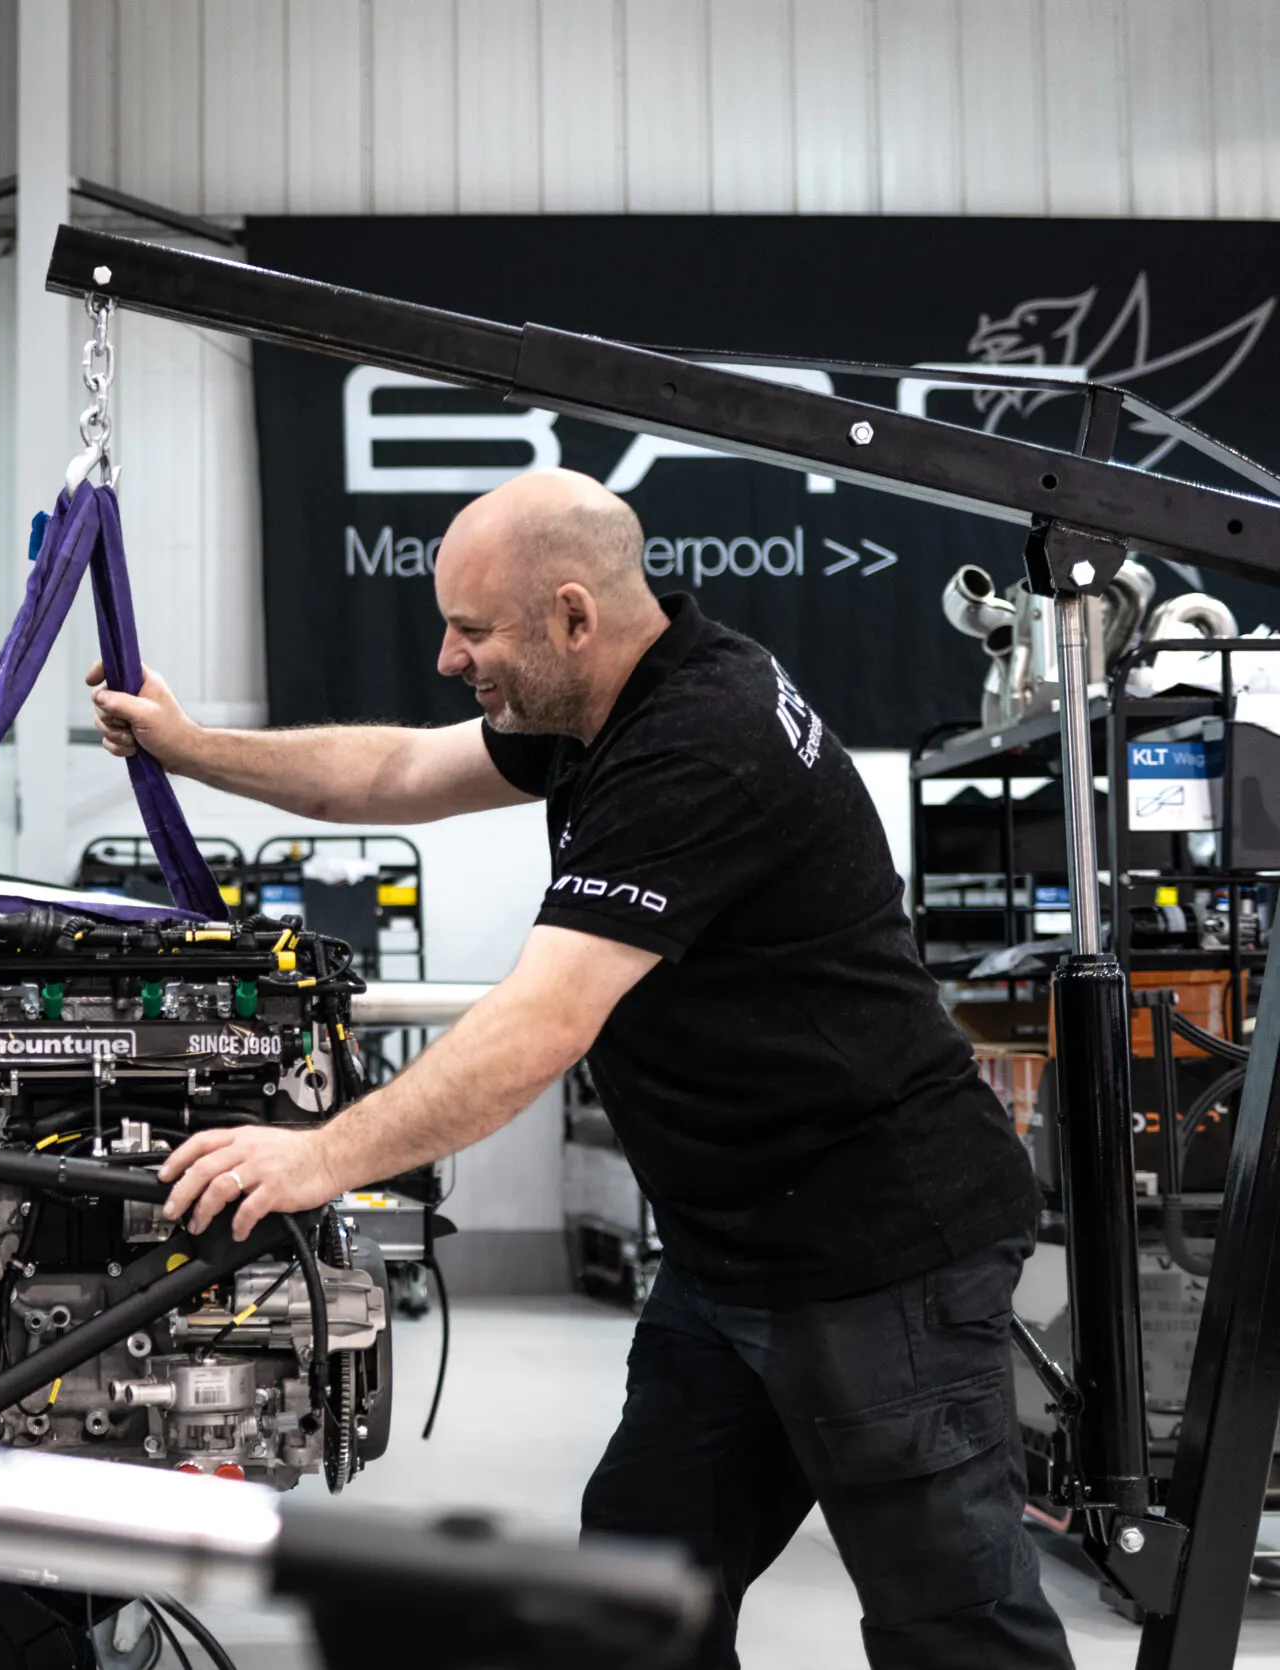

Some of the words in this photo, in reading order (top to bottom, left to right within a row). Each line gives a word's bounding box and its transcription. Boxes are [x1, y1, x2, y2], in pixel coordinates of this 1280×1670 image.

[345, 525, 442, 577] Ma
[643, 525, 805, 587] erpool
[1132, 748, 1169, 766] KLT
[189, 1034, 239, 1055] SINCE
[243, 1034, 282, 1056] 1980
